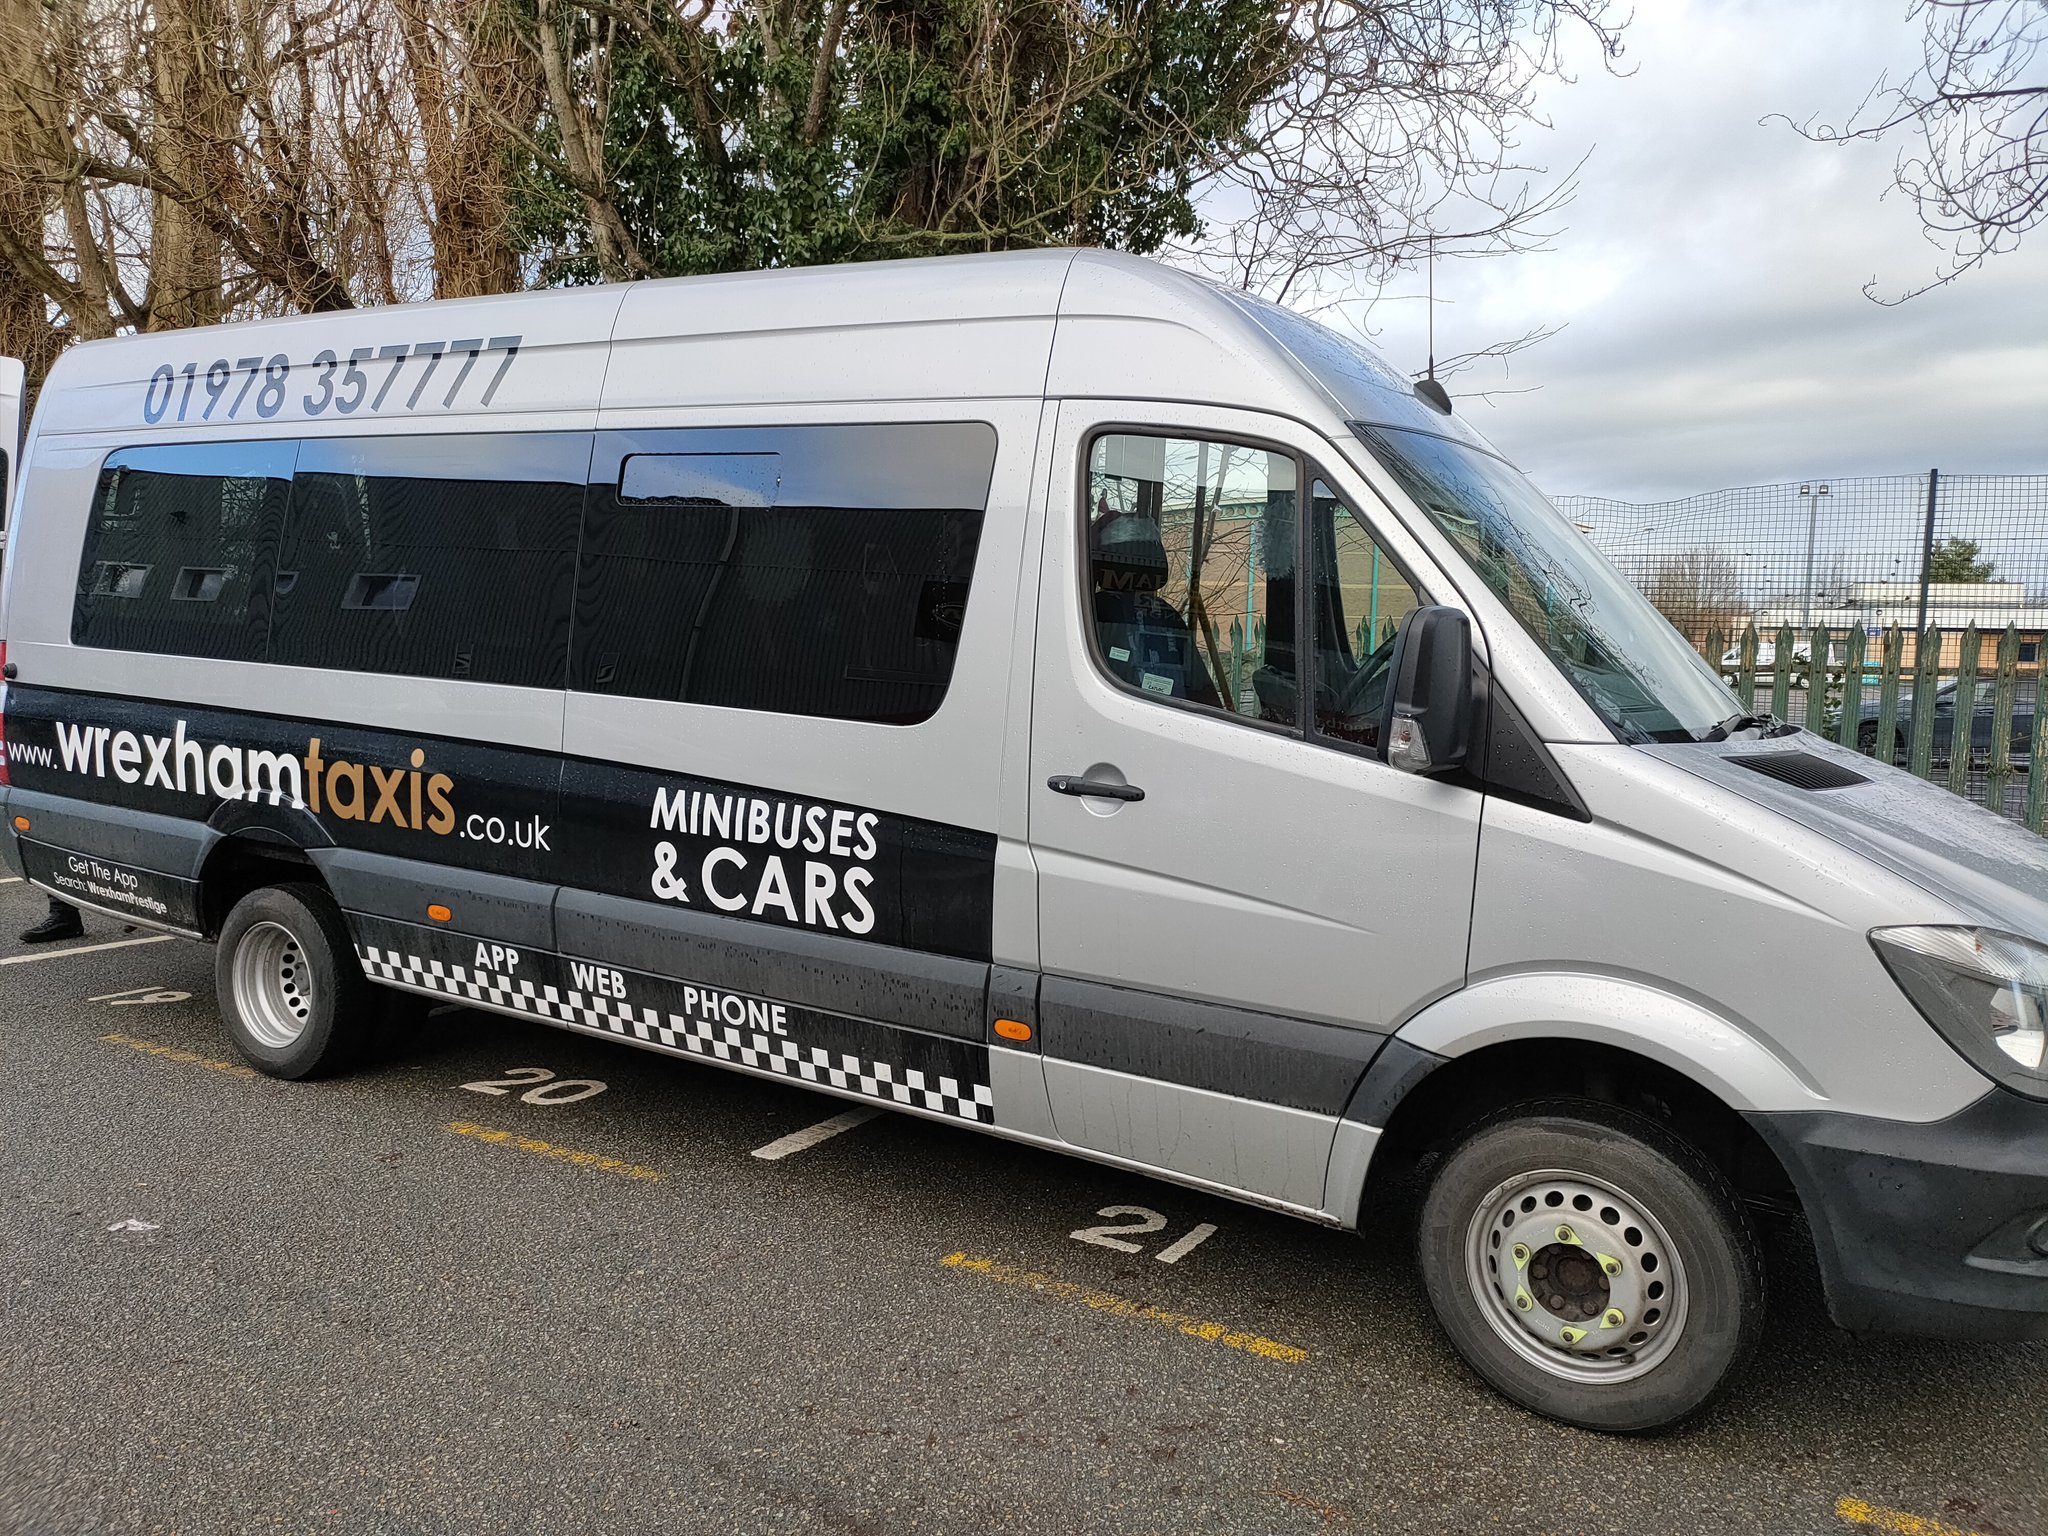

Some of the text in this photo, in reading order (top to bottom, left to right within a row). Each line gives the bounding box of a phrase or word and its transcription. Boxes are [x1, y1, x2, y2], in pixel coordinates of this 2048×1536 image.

[143, 335, 523, 425] 01978 357777
[650, 787, 879, 861] MINIBUSES
[53, 872, 167, 914] Search: WrexhamPrestige
[68, 856, 138, 890] Get The App
[650, 841, 875, 934] & CARS
[475, 942, 520, 975] APP
[87, 986, 192, 1005] 19
[570, 961, 627, 999] WEB
[683, 986, 788, 1036] PHONE
[458, 1068, 608, 1105] 20
[1069, 1205, 1218, 1264] 21
